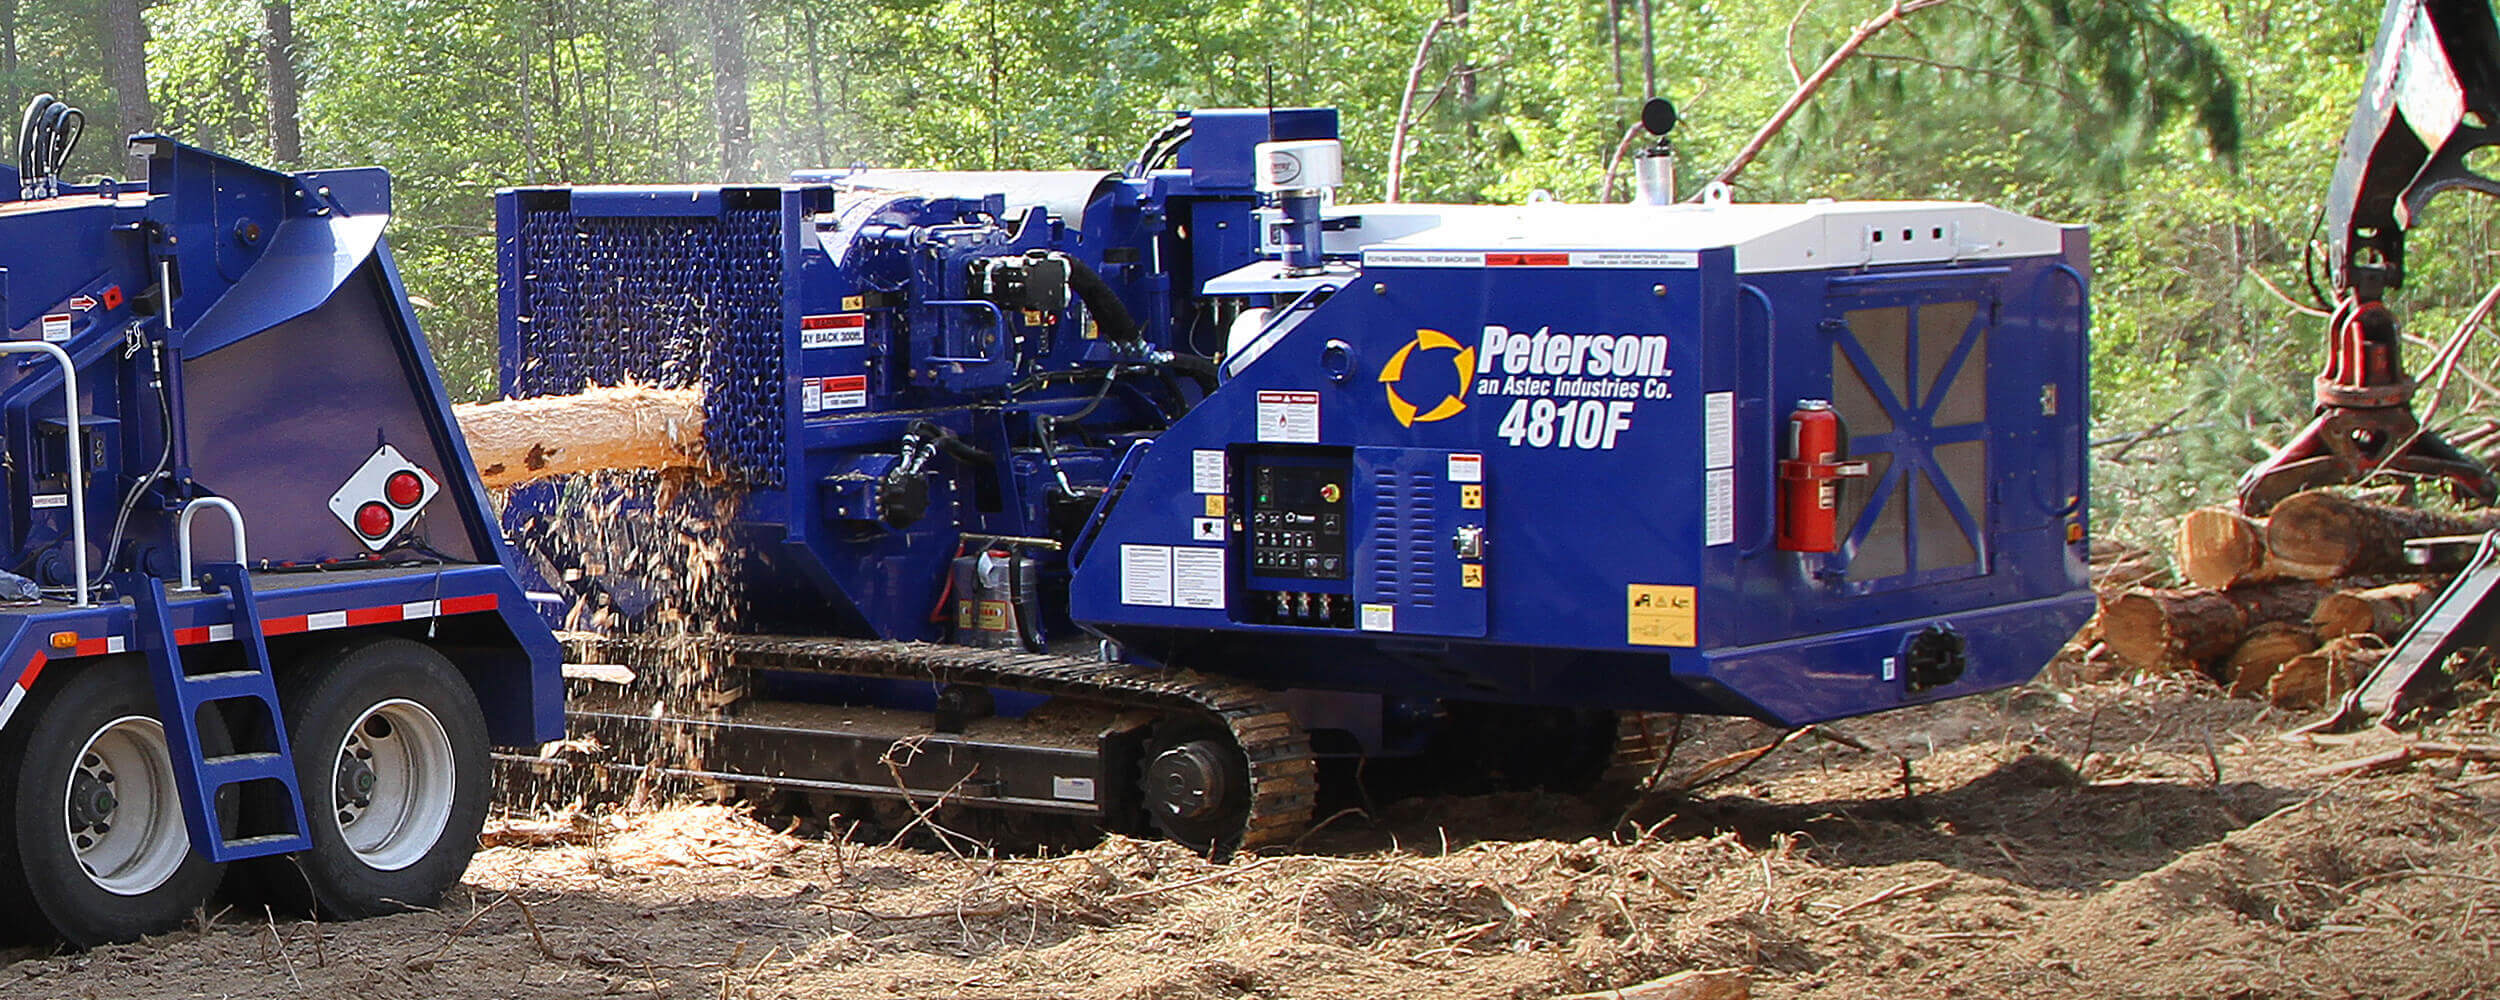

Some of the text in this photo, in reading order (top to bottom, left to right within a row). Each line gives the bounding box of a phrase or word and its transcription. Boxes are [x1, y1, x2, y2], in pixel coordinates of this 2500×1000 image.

[803, 333, 814, 344] AY
[815, 332, 839, 343] BACK
[1477, 376, 1673, 399] an Astec Industries Co.
[1498, 398, 1635, 449] 4810F
